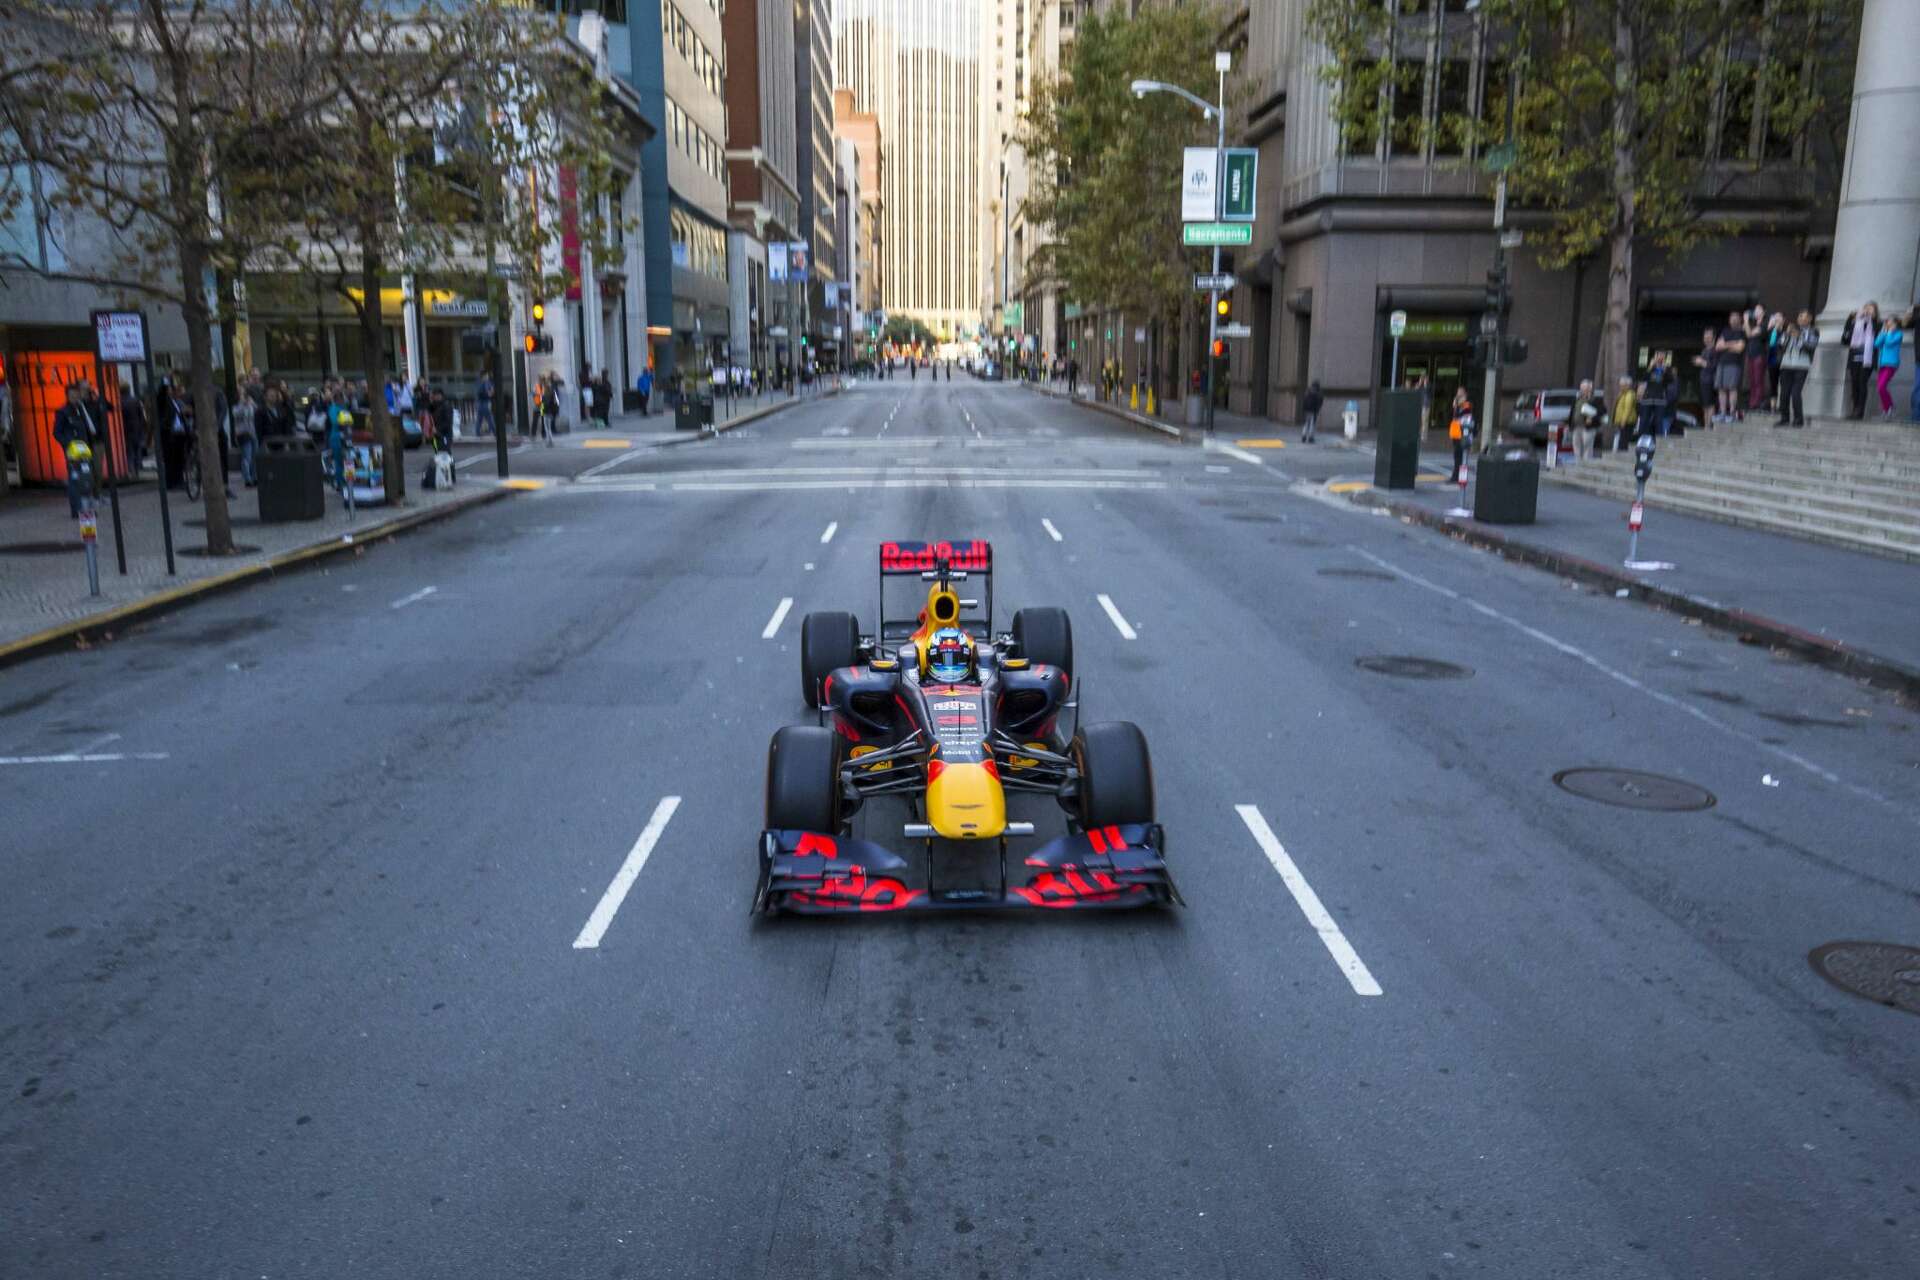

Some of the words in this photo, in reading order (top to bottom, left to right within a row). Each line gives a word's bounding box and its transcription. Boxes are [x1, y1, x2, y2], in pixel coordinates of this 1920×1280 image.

[1189, 226, 1248, 241] Sacramento
[882, 541, 934, 569] Red
[936, 539, 987, 569] Bull
